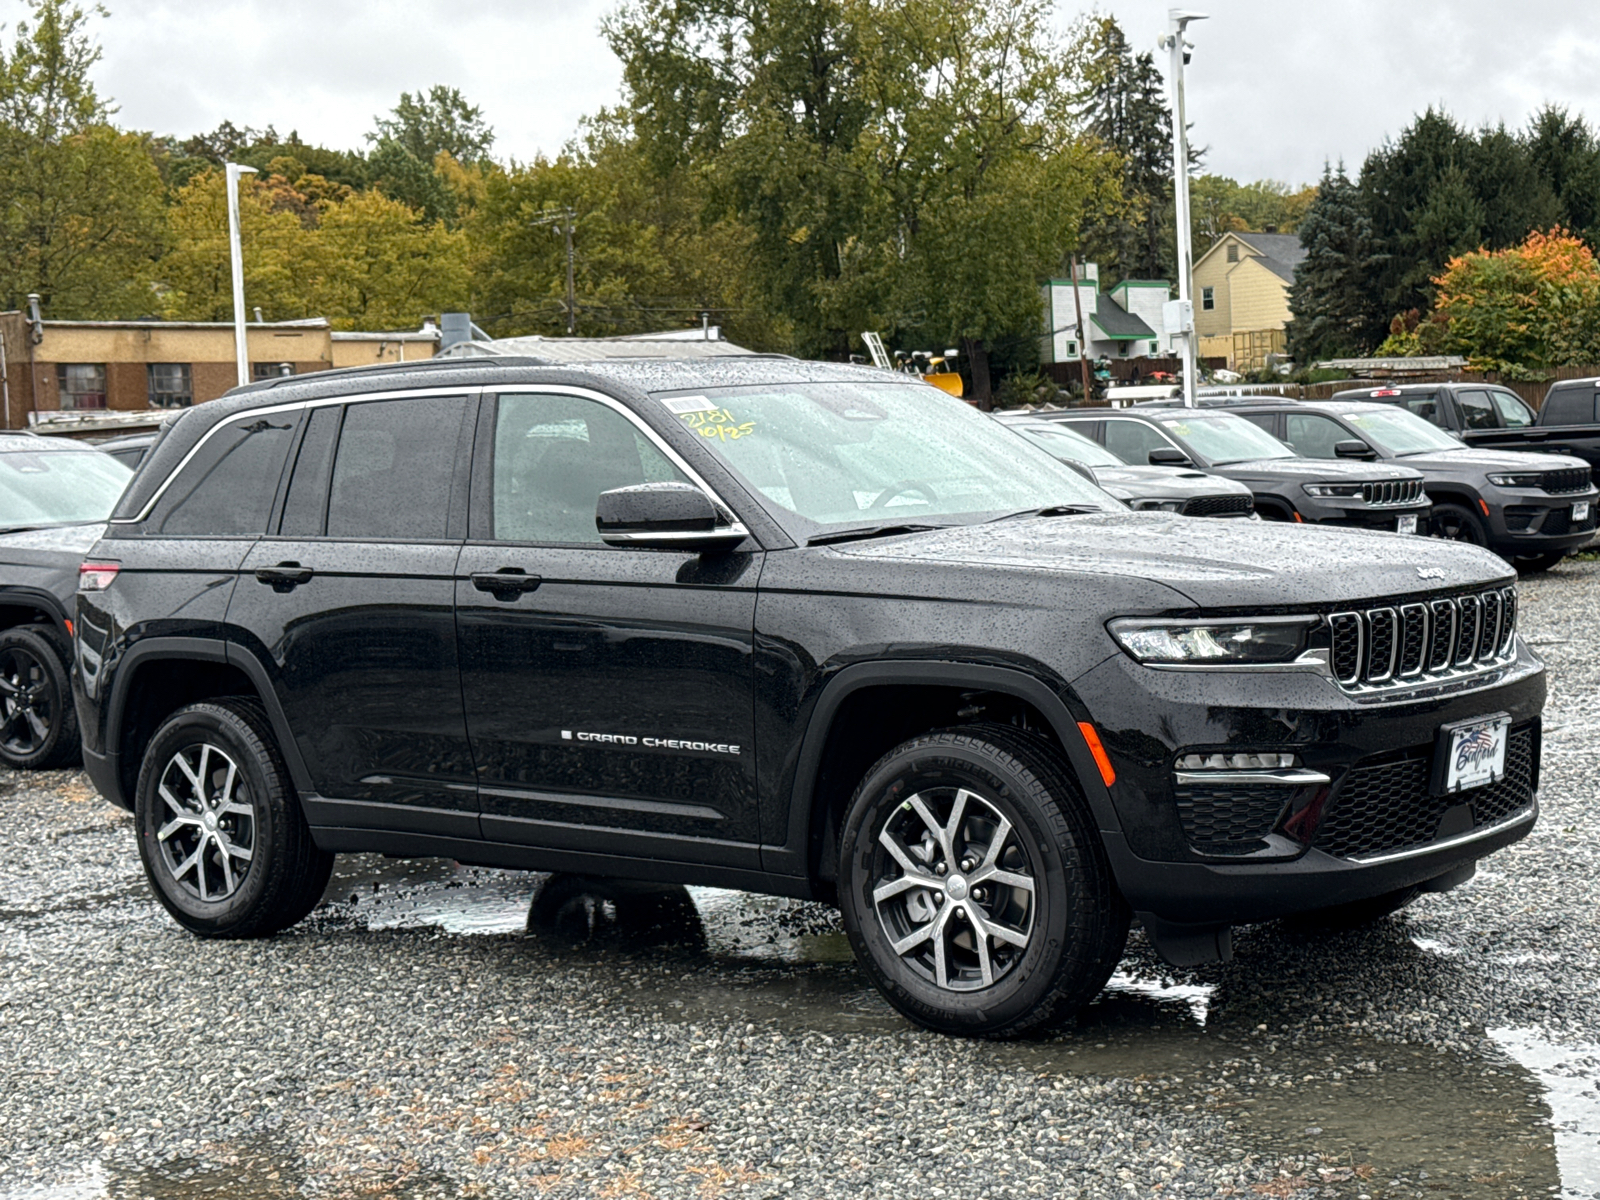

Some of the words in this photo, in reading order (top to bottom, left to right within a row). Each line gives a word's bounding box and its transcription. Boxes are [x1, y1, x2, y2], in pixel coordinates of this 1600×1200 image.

[697, 422, 757, 442] 10/25
[1416, 566, 1446, 581] Jeep
[577, 731, 638, 745] GRAND
[642, 737, 741, 755] CHEROKEE
